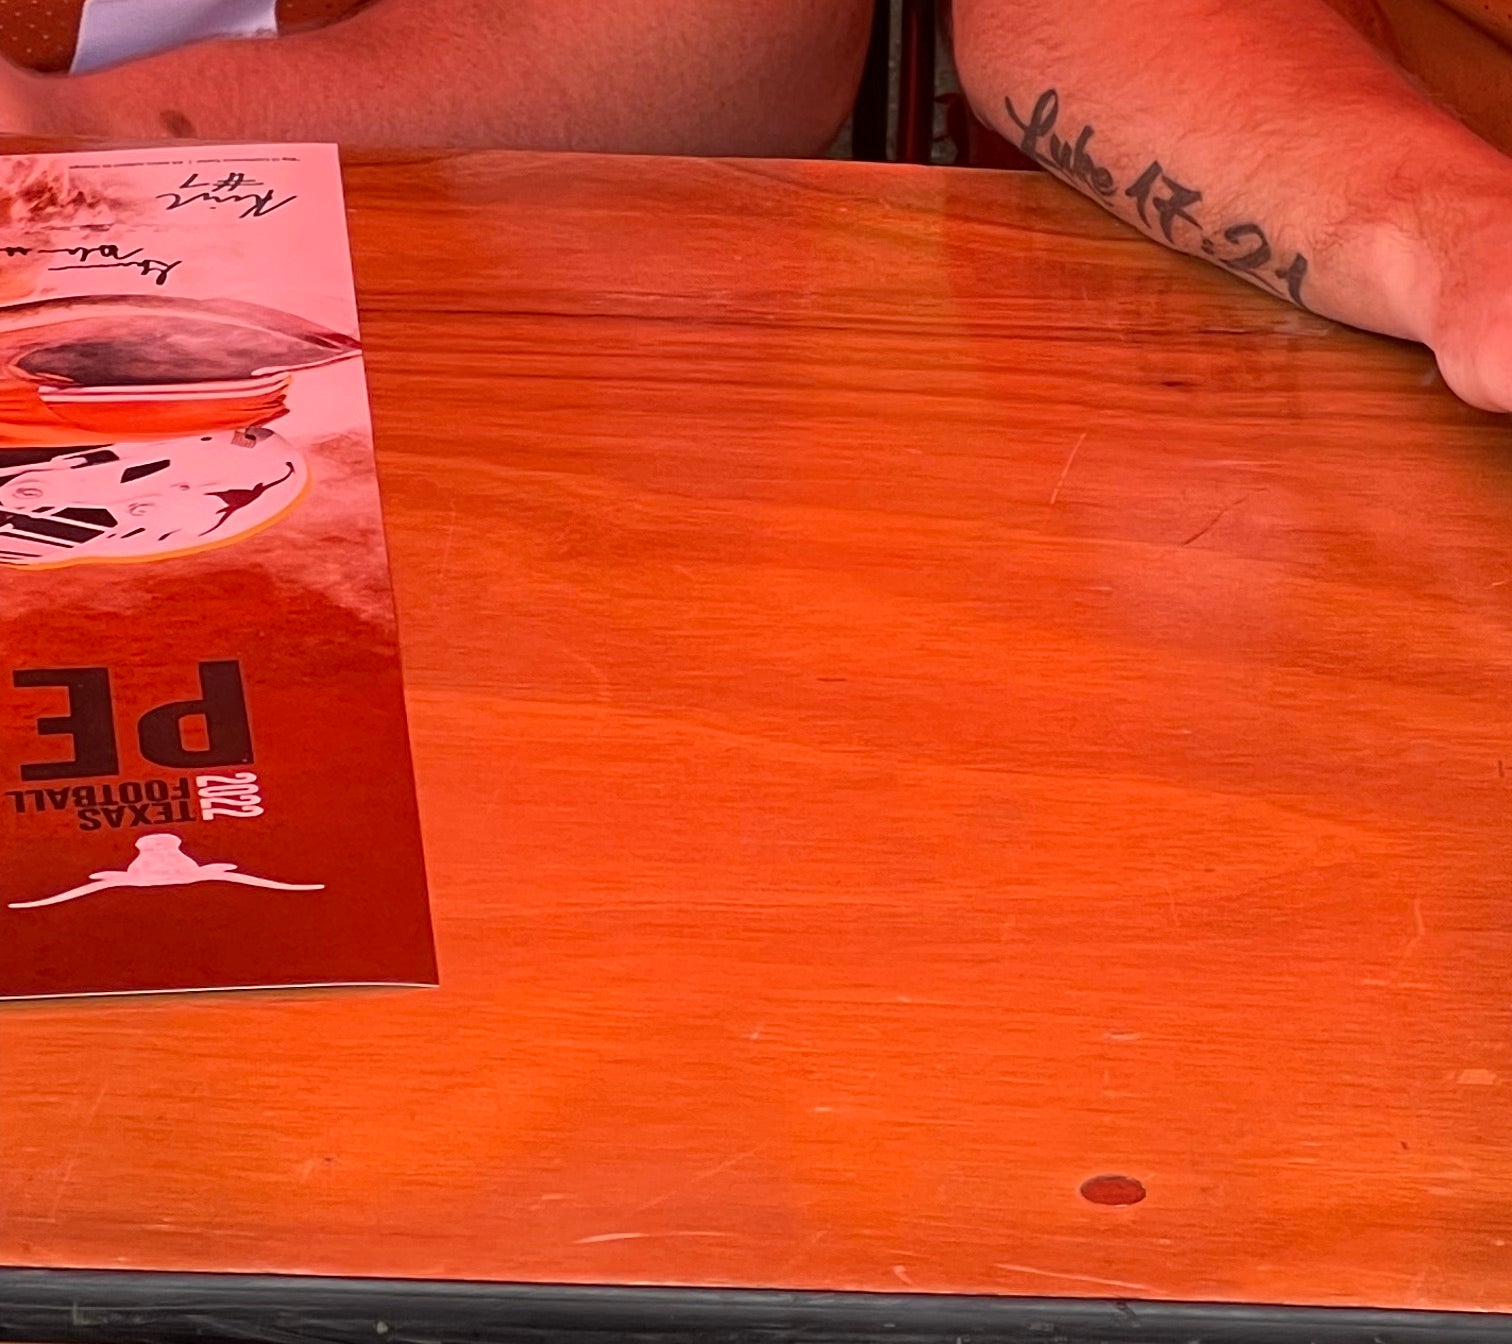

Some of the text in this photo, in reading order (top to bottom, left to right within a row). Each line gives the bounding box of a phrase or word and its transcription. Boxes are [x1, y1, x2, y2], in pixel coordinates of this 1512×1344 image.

[5, 778, 190, 813] FOOTBALL
[196, 772, 264, 820] 2022
[77, 801, 196, 831] TEXAS
